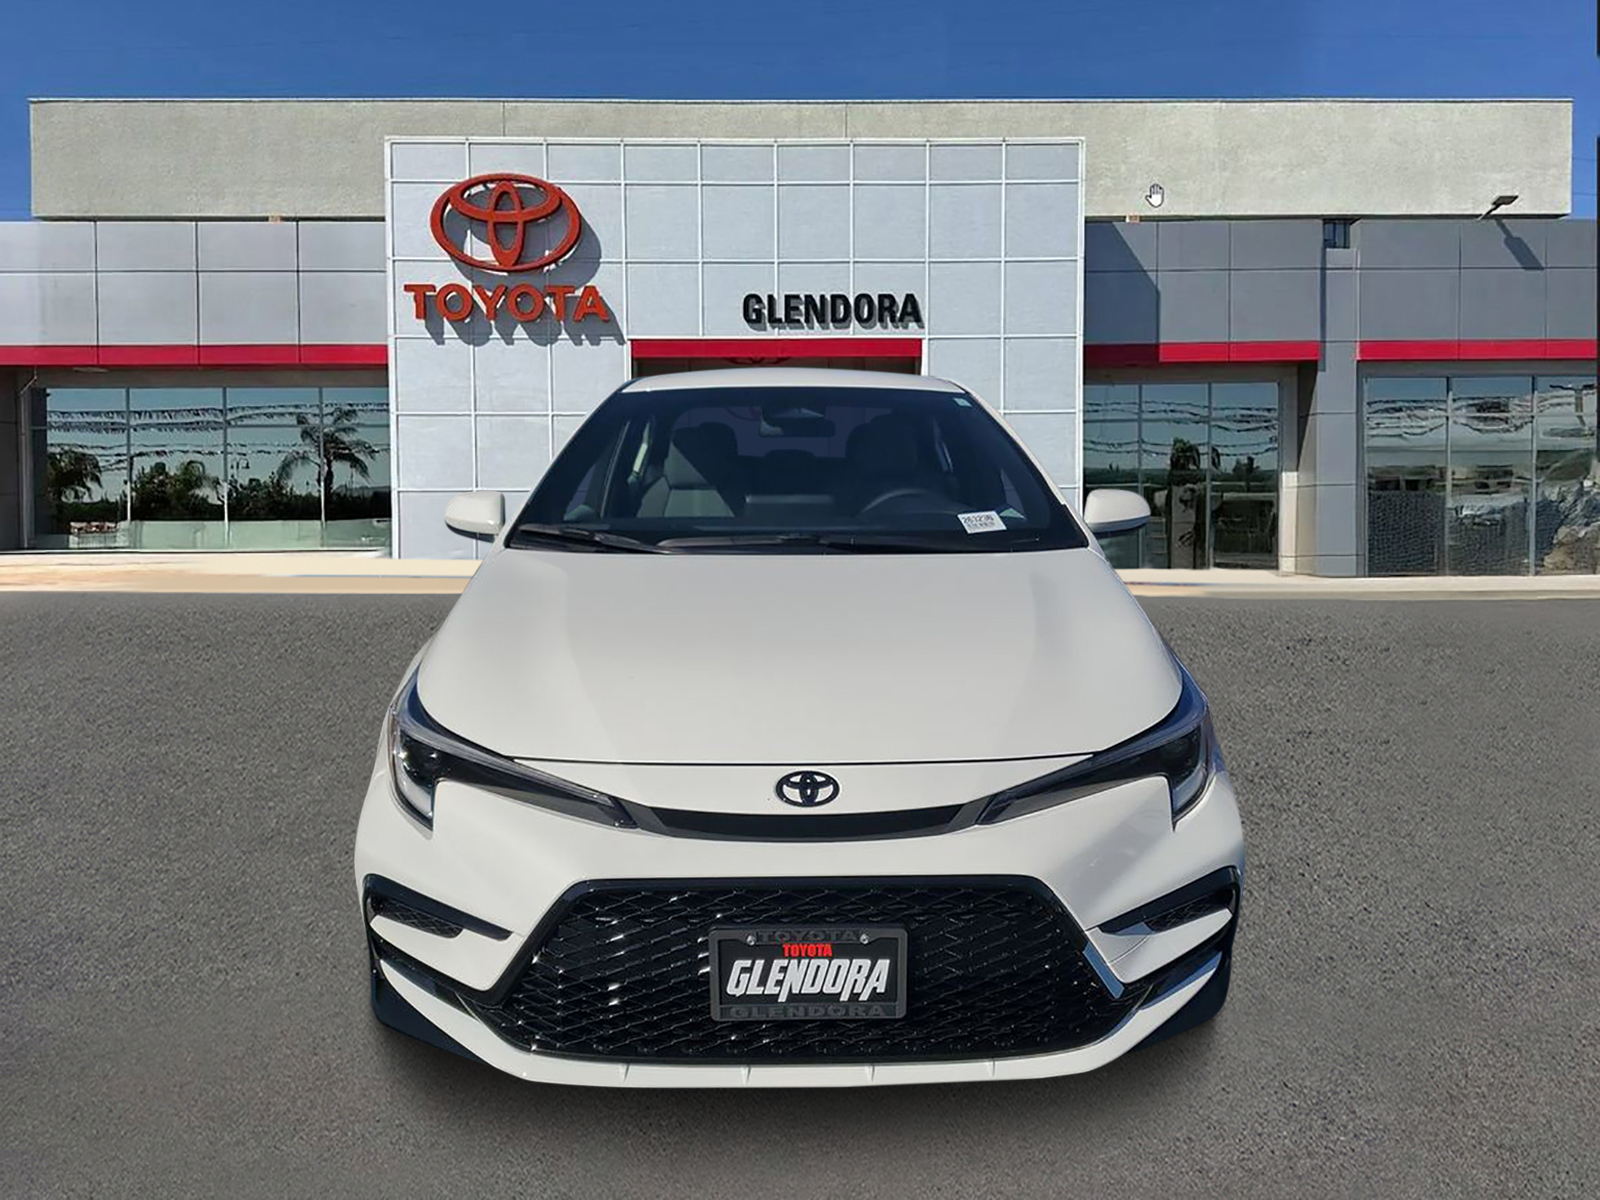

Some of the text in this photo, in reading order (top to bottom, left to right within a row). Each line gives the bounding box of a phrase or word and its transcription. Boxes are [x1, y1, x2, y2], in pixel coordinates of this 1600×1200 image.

[404, 284, 609, 322] TOYOTA
[743, 293, 923, 326] GLENDORA
[757, 930, 857, 942] TOYOTA
[782, 943, 833, 957] TOYOTA
[726, 958, 891, 1002] GLENDORA
[729, 1004, 887, 1018] GLENDORA
